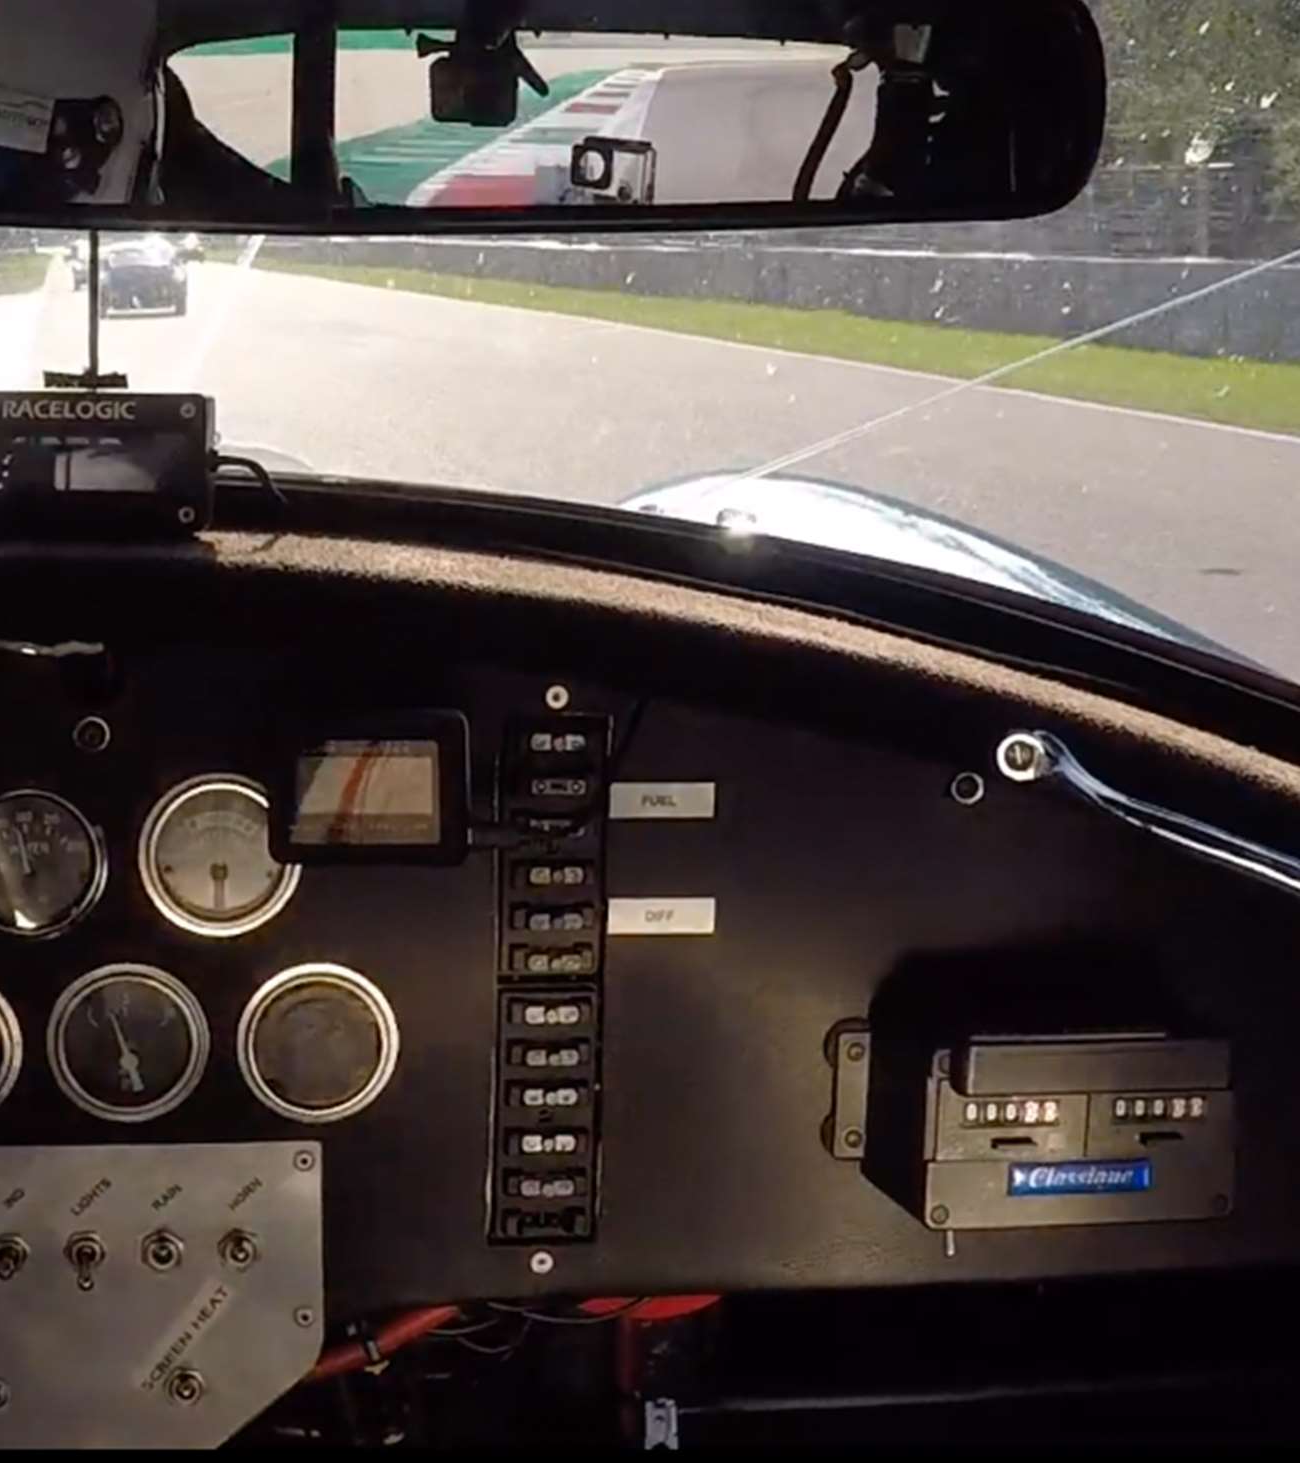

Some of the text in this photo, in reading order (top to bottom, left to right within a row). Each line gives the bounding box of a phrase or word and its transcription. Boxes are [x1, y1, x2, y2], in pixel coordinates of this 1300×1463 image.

[2, 400, 137, 420] RACELOGIC
[640, 795, 678, 808] FUEL
[70, 1177, 113, 1217] LIGHTS
[151, 1183, 183, 1211] RAIN
[228, 1177, 263, 1211] HORN
[141, 1286, 229, 1392] SCREEN HEAT
